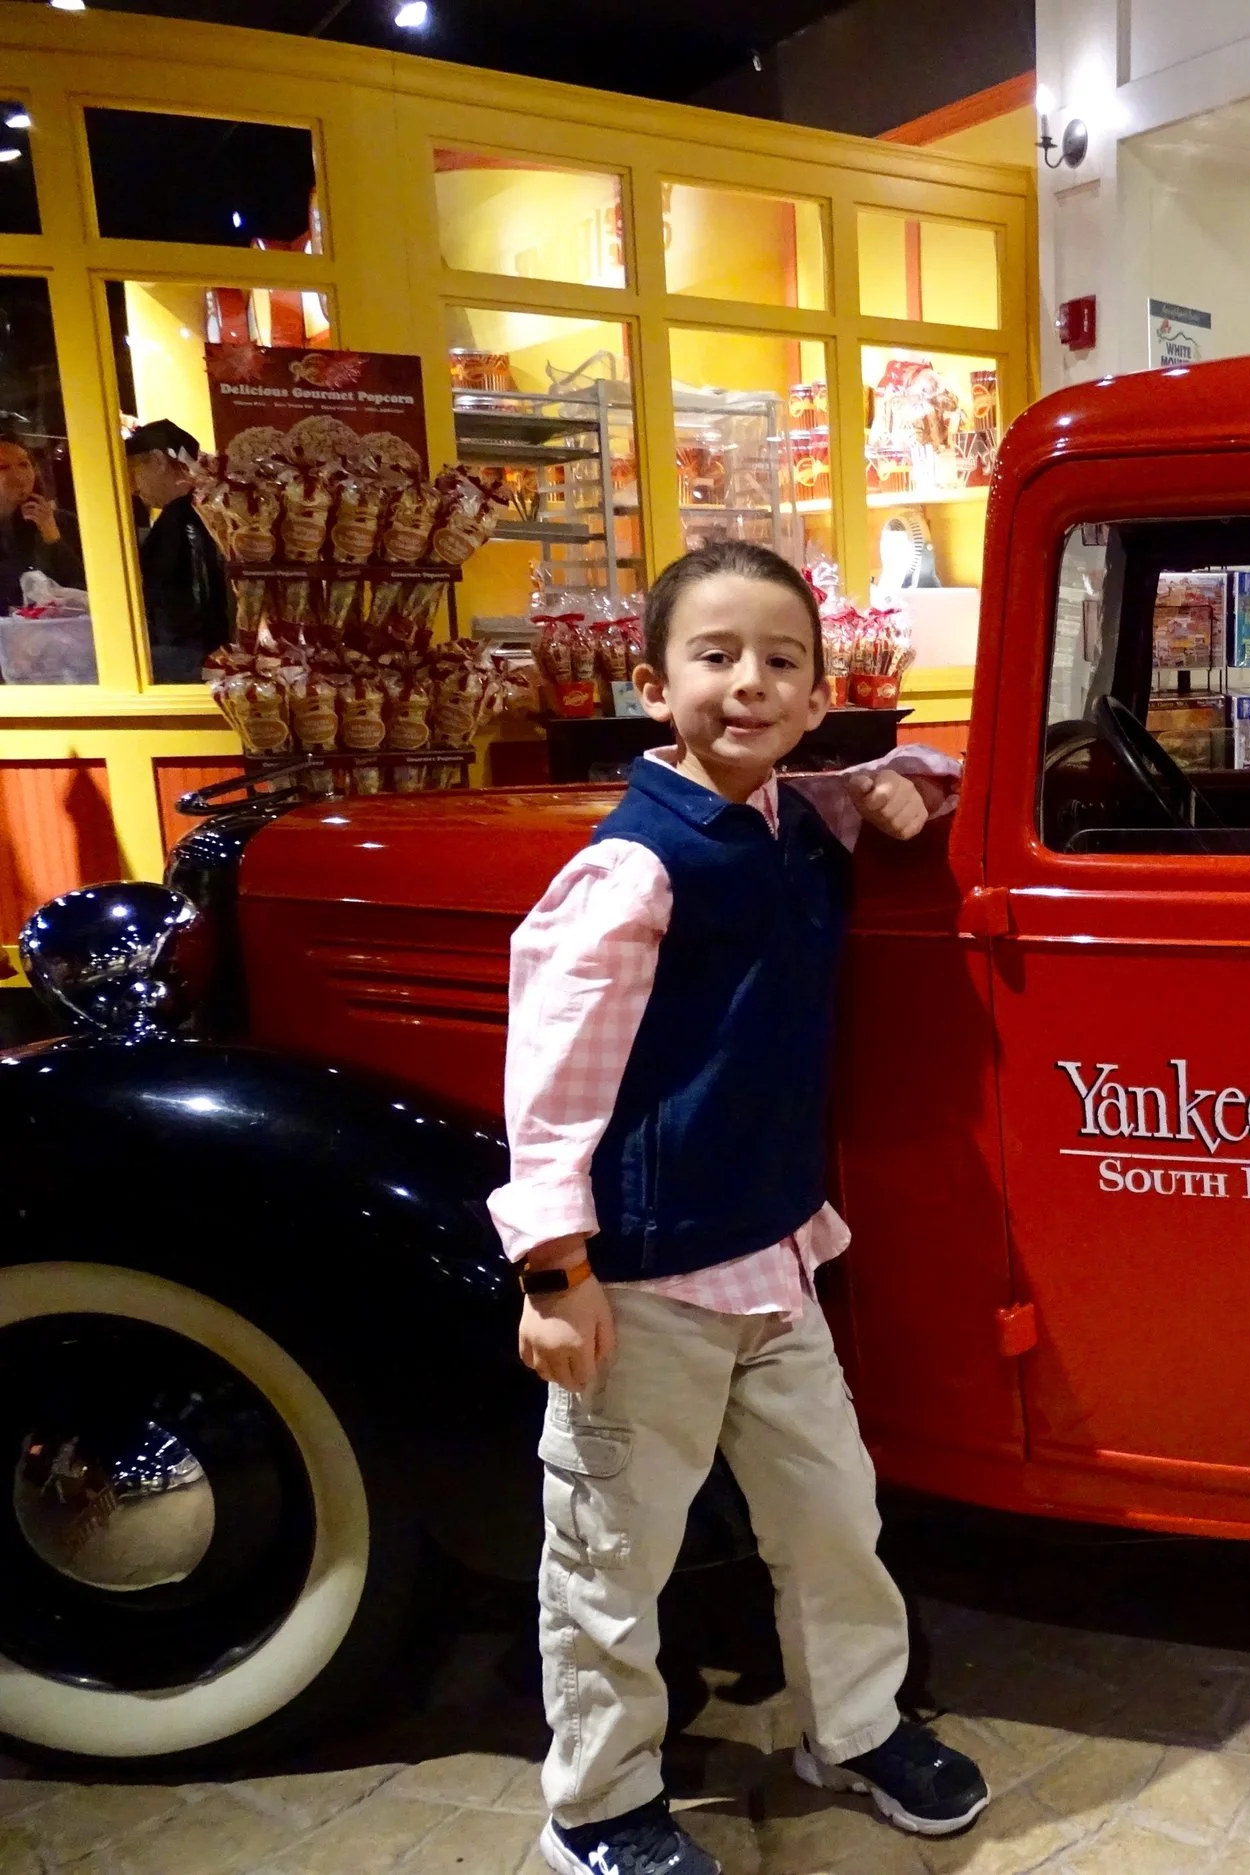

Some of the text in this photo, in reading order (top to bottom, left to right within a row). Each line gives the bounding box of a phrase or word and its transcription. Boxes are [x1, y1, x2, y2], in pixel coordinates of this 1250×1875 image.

[1166, 342, 1191, 359] WHITE
[219, 383, 415, 406] Delicious Gourmet Popcorn
[1098, 1159, 1228, 1199] SOUTH
